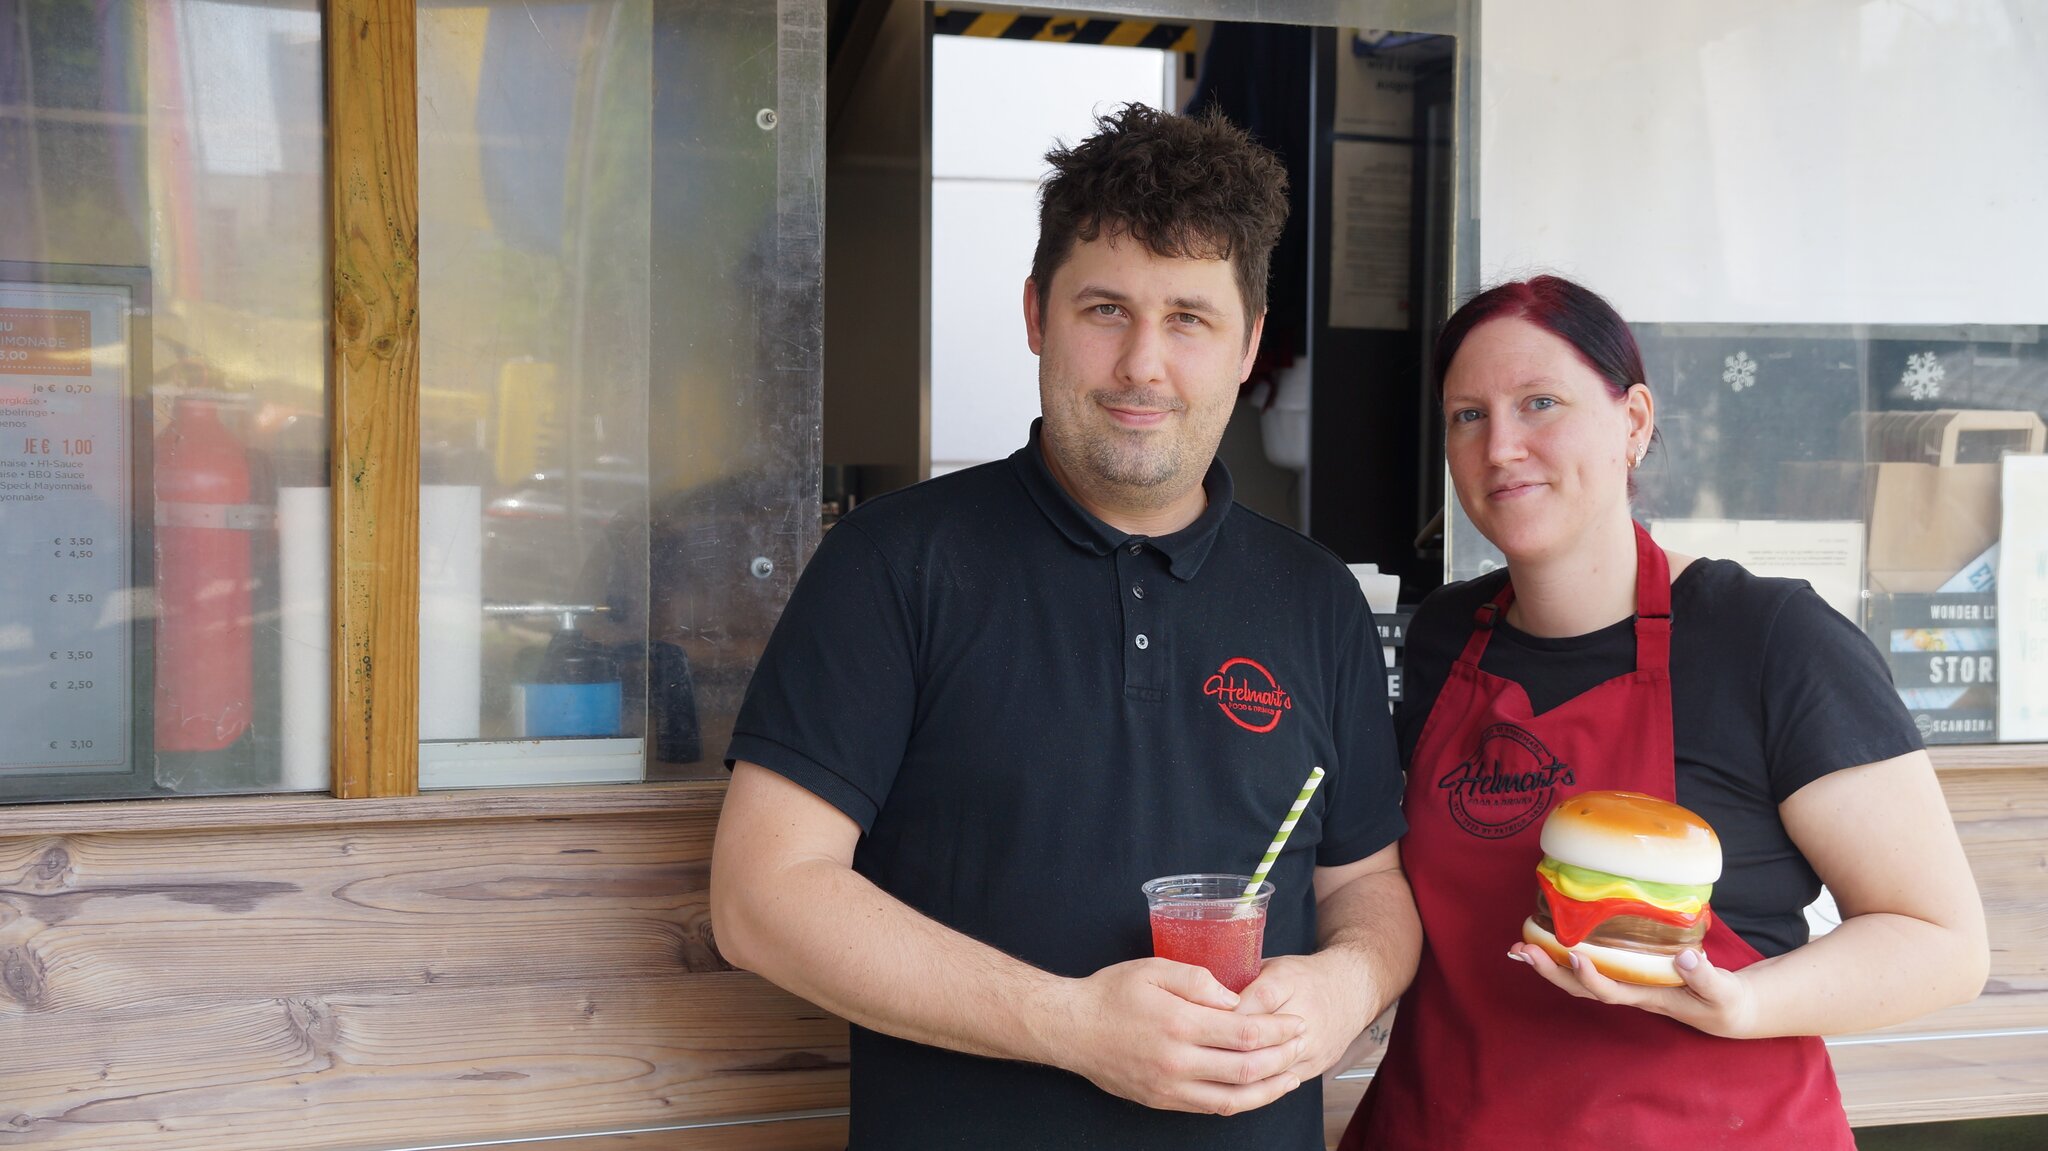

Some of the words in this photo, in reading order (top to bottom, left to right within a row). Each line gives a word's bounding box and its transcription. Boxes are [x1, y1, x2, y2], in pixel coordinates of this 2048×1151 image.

[65, 384, 92, 394] 0,70
[24, 438, 38, 454] JE
[41, 438, 50, 454] €
[63, 439, 93, 456] 1,00
[28, 470, 52, 479] BBQ
[54, 470, 85, 479] Sauce
[34, 481, 93, 491] Mayonnaise
[70, 537, 93, 546] 3,50
[69, 550, 93, 559] 4,50
[67, 594, 93, 604] 3,50
[1930, 604, 1981, 620] WONDER
[67, 651, 93, 661] 3,50
[1929, 656, 1993, 684] STOR
[67, 680, 93, 690] 2,50
[1229, 702, 1247, 711] FOOD
[1933, 719, 1993, 732] SCANDINA
[70, 740, 93, 750] 3,10
